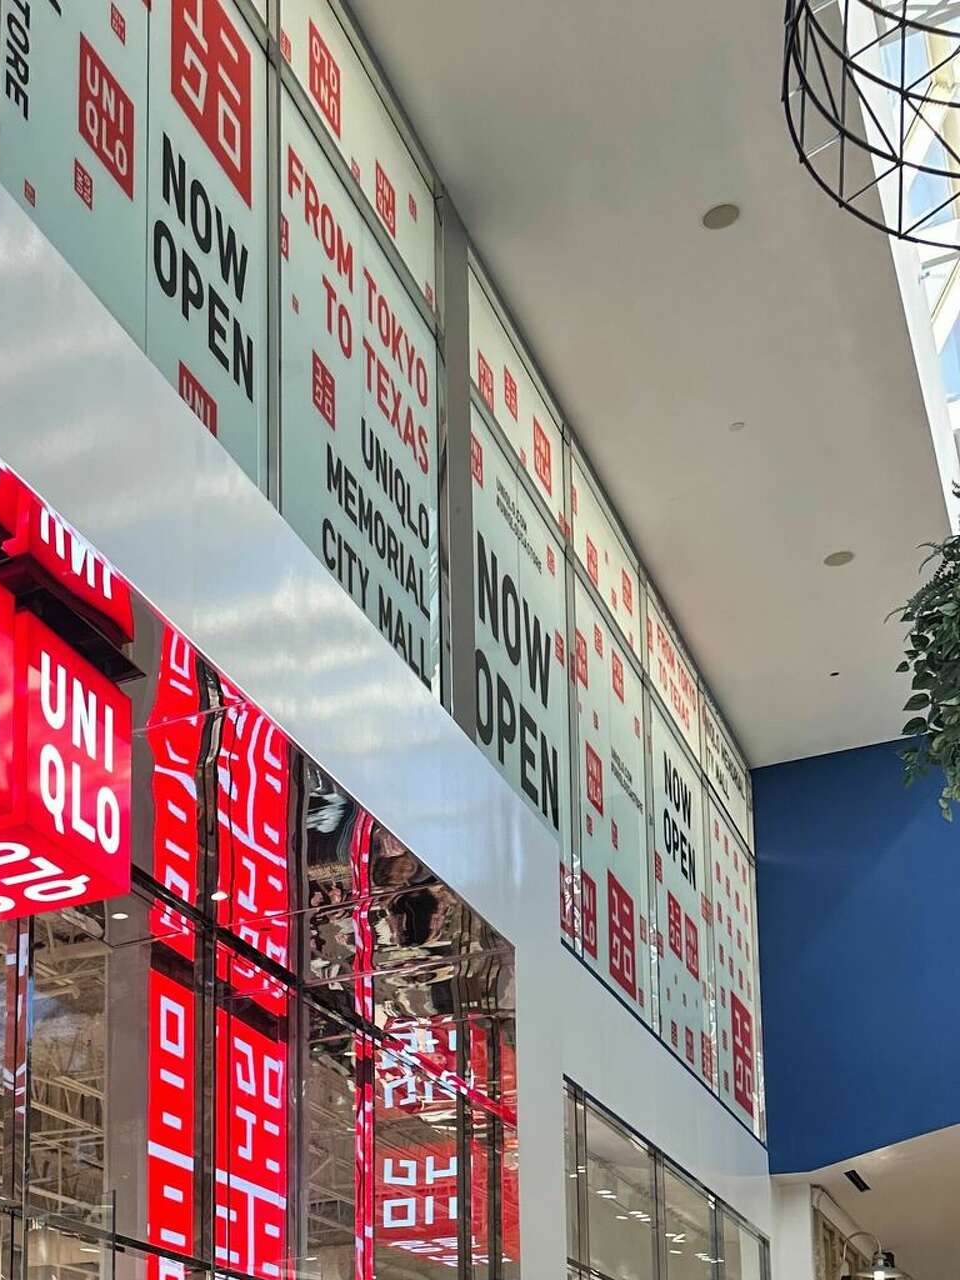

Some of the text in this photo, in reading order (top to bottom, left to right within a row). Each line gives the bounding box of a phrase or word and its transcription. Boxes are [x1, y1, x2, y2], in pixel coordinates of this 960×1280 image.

[85, 100, 127, 176] QLO
[86, 55, 125, 135] UNI
[163, 131, 248, 303] NOW
[288, 144, 428, 407] FROM TOKYO
[154, 220, 253, 403] OPEN
[323, 273, 428, 475] TO TEXAS
[327, 442, 431, 621] MEMORIAL
[361, 417, 429, 549] UNIQLO
[322, 518, 432, 692] CITY MALL
[477, 530, 551, 709] NOW
[41, 651, 114, 773] UNI
[476, 649, 559, 831] OPEN
[664, 750, 691, 829] NOW
[40, 744, 120, 854] QLO
[664, 808, 696, 891] OPEN
